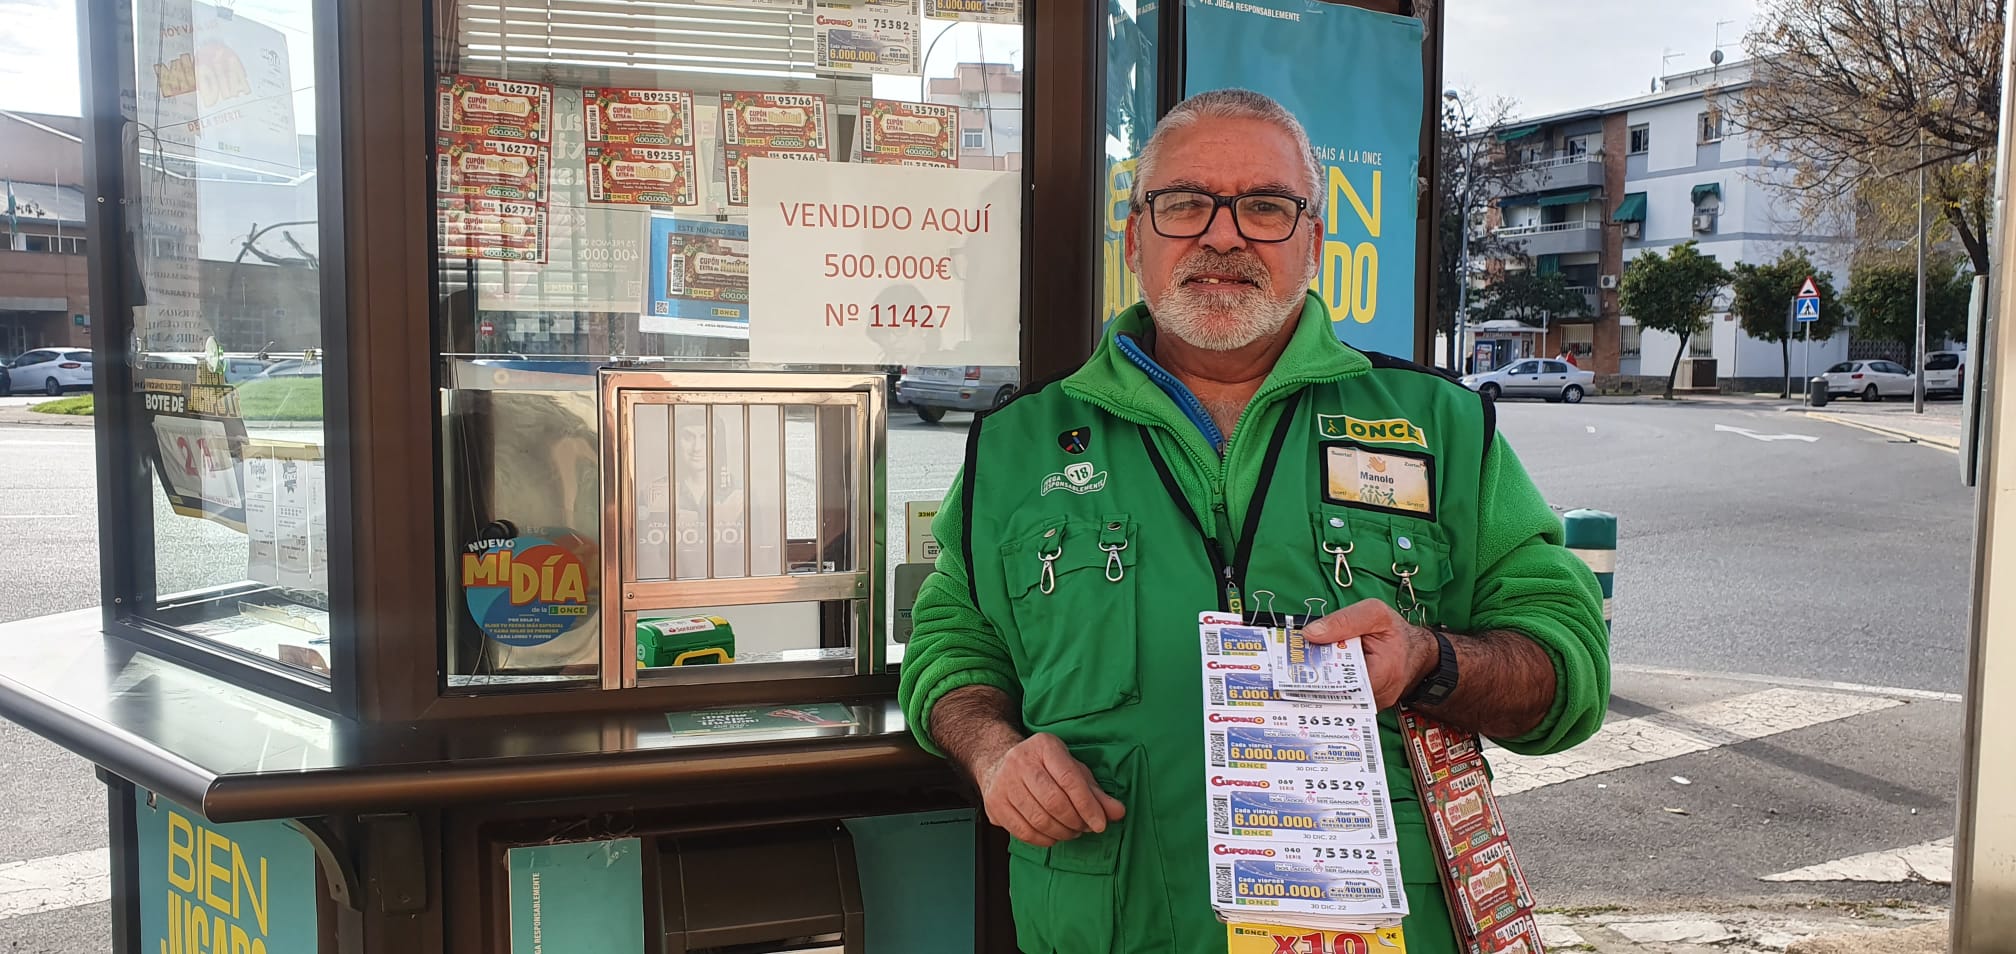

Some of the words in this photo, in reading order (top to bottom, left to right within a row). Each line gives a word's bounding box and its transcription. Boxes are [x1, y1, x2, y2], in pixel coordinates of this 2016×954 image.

[1215, 0, 1234, 10] JUEGA
[1236, 3, 1300, 22] RESPONSABLEMENTE
[874, 19, 910, 30] 75382
[502, 83, 538, 96] 16277
[643, 92, 679, 102] 89255
[778, 96, 811, 106] 95766
[914, 105, 946, 116] 35798
[500, 143, 536, 156] 16277
[646, 150, 681, 160] 89255
[1339, 148, 1345, 161] A
[1348, 150, 1359, 163] LA
[1362, 151, 1382, 166] ONCE
[498, 204, 534, 216] 16277
[780, 202, 912, 230] VENDIDO
[920, 203, 991, 235] AQUÍ
[824, 253, 952, 280] 500.000€
[825, 303, 859, 327] Nº
[870, 303, 951, 328] 11427
[145, 393, 171, 412] BOTE
[171, 396, 185, 413] DE
[1350, 423, 1420, 441] ONCE
[1360, 471, 1394, 485] Manolo
[468, 539, 515, 552] NUEVO
[464, 550, 511, 585] MI
[511, 554, 586, 604] DÍA
[676, 624, 706, 632] Santander
[1208, 713, 1265, 725] CUPONAZO
[1298, 715, 1356, 727] 36529
[1231, 747, 1311, 761] 6.000.000€
[1211, 775, 1270, 789] CUPONAZO
[1305, 779, 1365, 791] 36529
[1458, 773, 1480, 791] 24461
[1234, 813, 1318, 829] 6.000.000€
[1213, 843, 1276, 857] CUPONAZO
[1312, 847, 1377, 860] 75382
[1482, 844, 1503, 864] 24461
[168, 810, 268, 937] BIEN
[1238, 882, 1327, 898] 6.000.000€
[532, 872, 541, 943] RESPONSABLEMENTE
[1505, 919, 1525, 938] 16277
